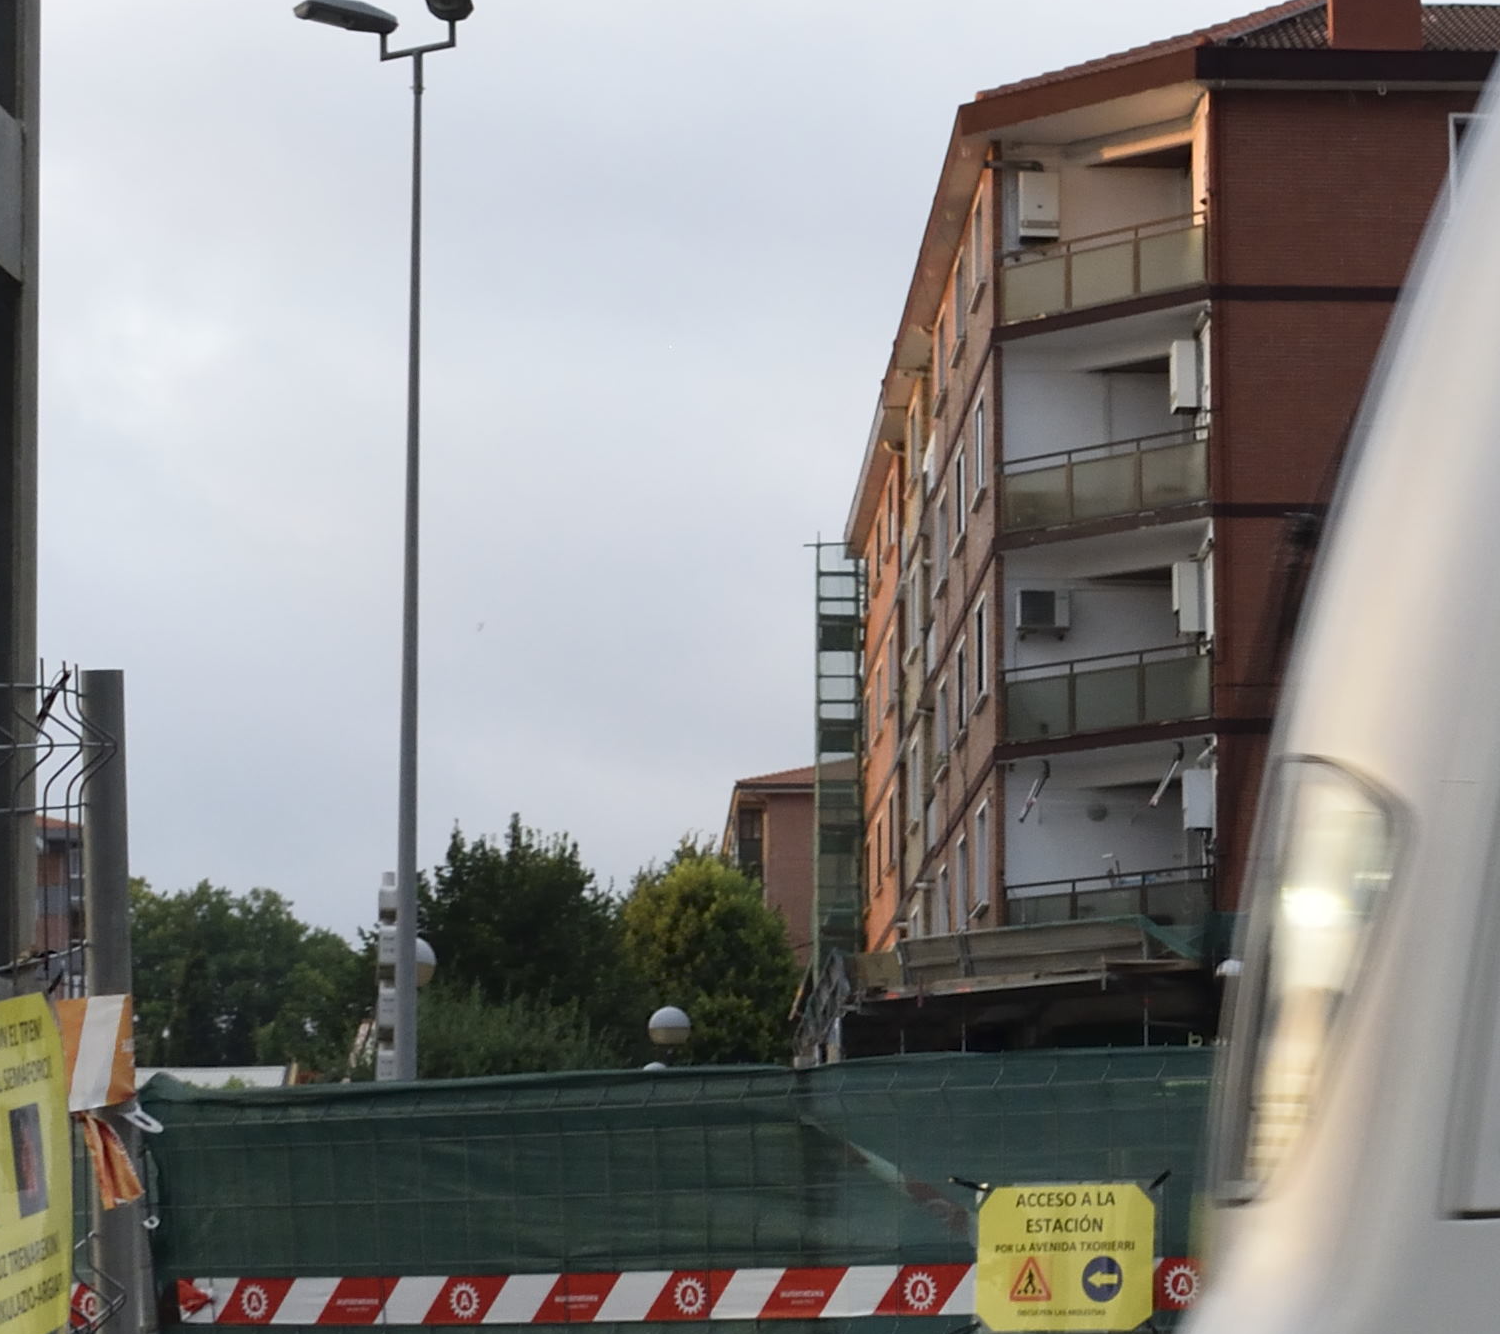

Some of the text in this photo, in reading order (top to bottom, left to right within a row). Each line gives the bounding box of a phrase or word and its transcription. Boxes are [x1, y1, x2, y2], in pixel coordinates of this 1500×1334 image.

[1015, 1191, 1115, 1208] ACCESO A LA
[1025, 1213, 1103, 1233] ESTACIÓN
[995, 1244, 1013, 1253] POR
[1015, 1244, 1026, 1253] LA
[1028, 1241, 1077, 1252] AVENIDA
